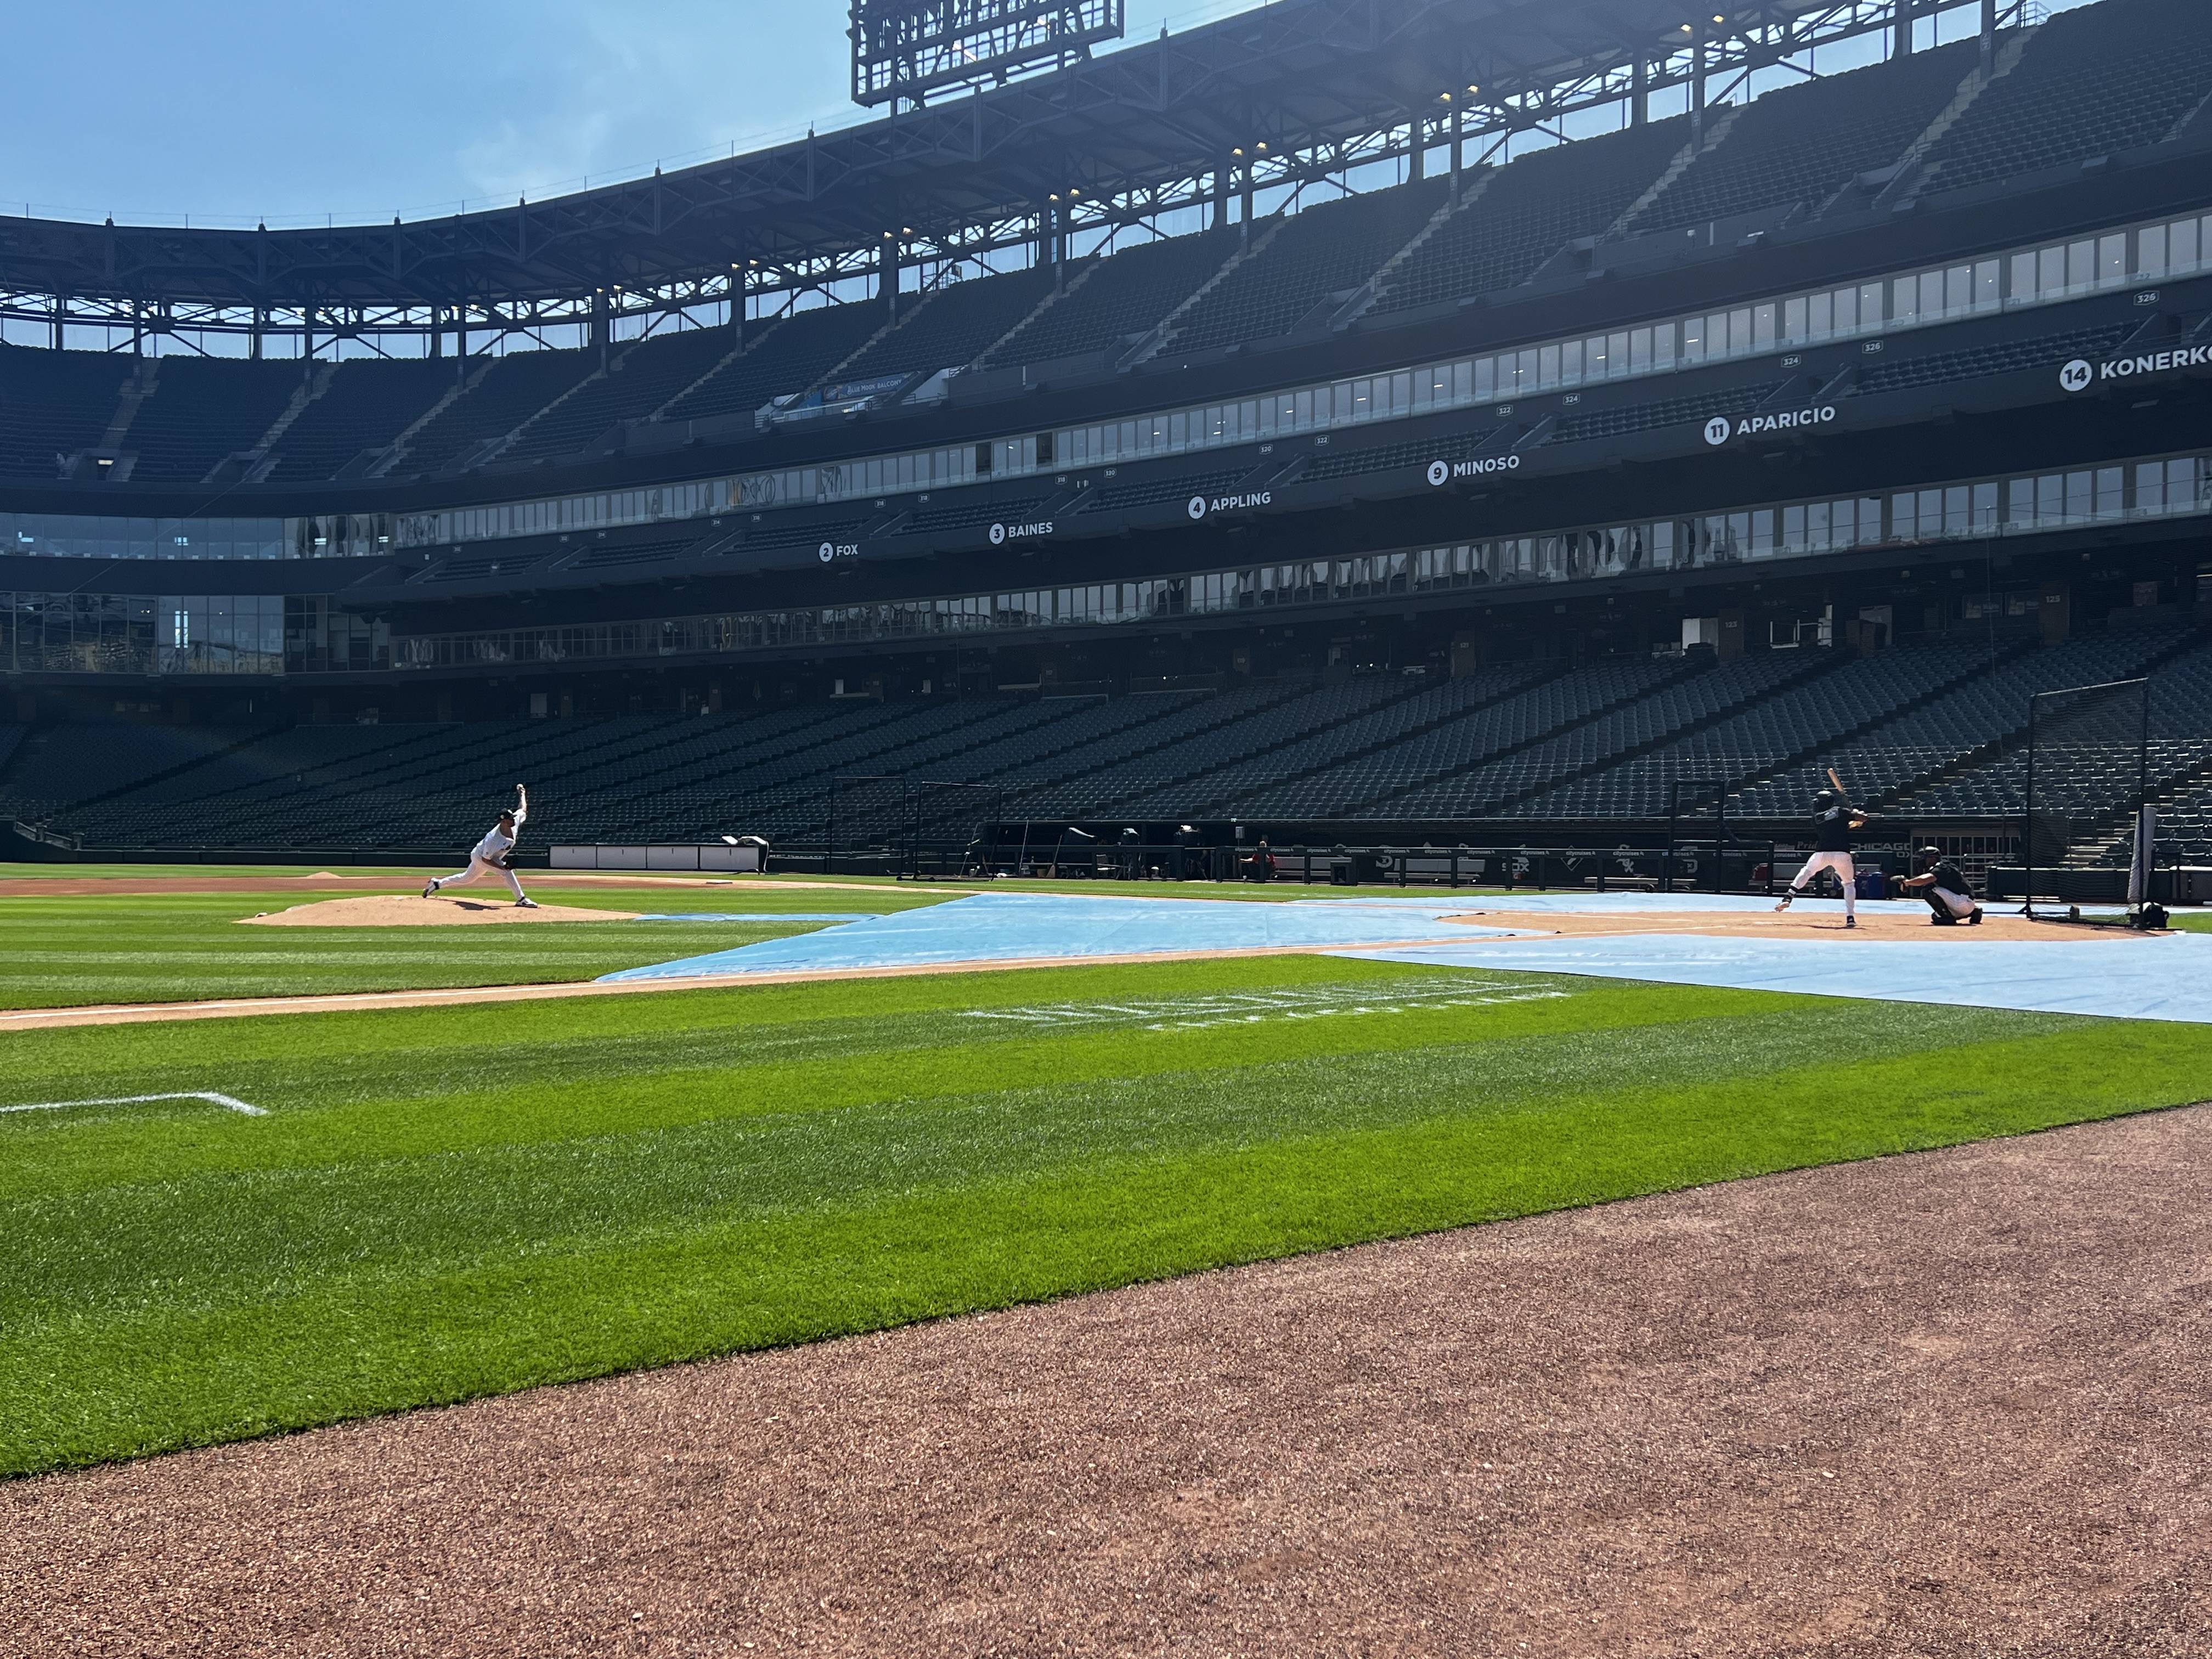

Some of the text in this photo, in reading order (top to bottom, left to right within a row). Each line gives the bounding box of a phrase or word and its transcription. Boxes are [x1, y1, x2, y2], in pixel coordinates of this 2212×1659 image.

[2137, 292, 2156, 303] 326
[1865, 342, 1881, 351] 326
[1784, 357, 1798, 365] 324
[2064, 345, 2212, 384] 14 KONERK
[861, 383, 876, 392] MOON
[877, 379, 902, 389] BALCONY
[1498, 407, 1511, 415] 322
[1711, 406, 1836, 438] 11 APARICIO
[1433, 455, 1520, 479] 9 MINOSO
[1193, 492, 1271, 513] 4 APPLING
[994, 522, 1053, 539] 3 BAINES
[823, 544, 859, 557] 2 FOX
[2046, 595, 2061, 603] 125
